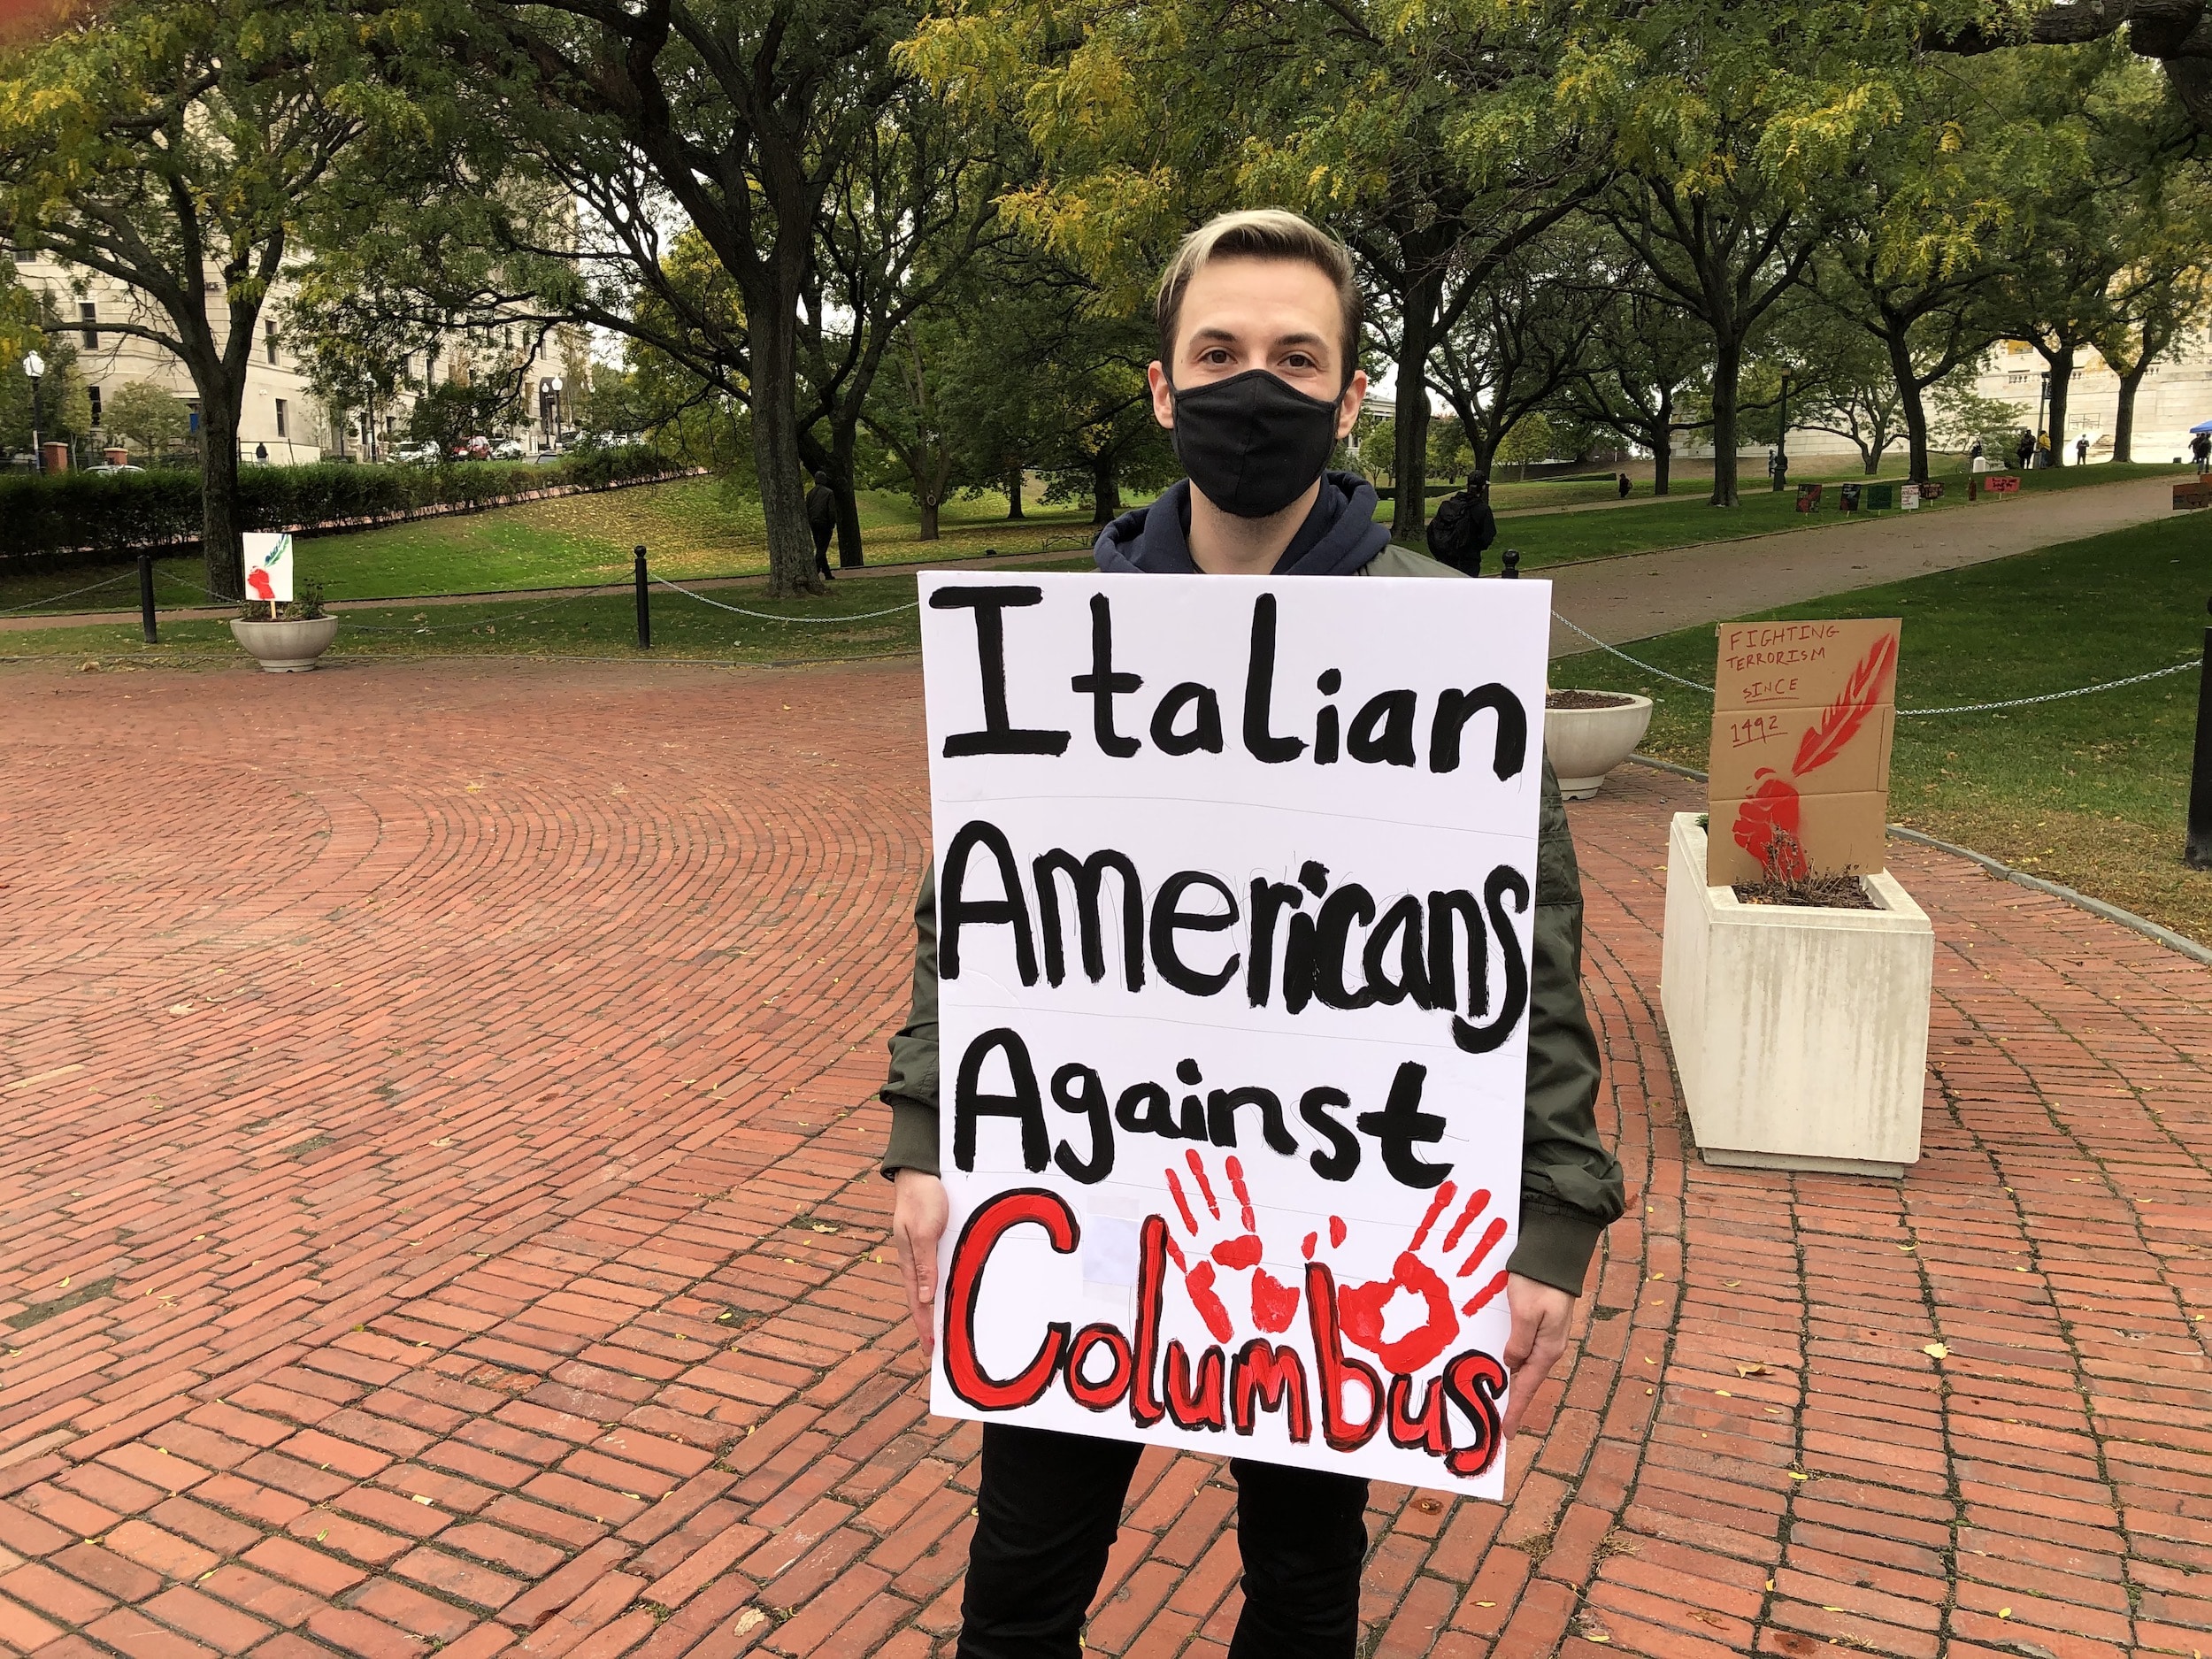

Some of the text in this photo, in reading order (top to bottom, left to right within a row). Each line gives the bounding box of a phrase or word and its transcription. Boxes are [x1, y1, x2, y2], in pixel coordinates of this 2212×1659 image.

[929, 586, 1527, 781] Italian
[1726, 647, 1825, 672] TERRORISM
[1730, 624, 1839, 650] FIGHTING
[1731, 715, 1778, 744] 1492
[1742, 678, 1799, 699] SINCE
[940, 820, 1530, 1054] Americans
[953, 1027, 1455, 1188] Against
[943, 1187, 1507, 1478] Columbus
